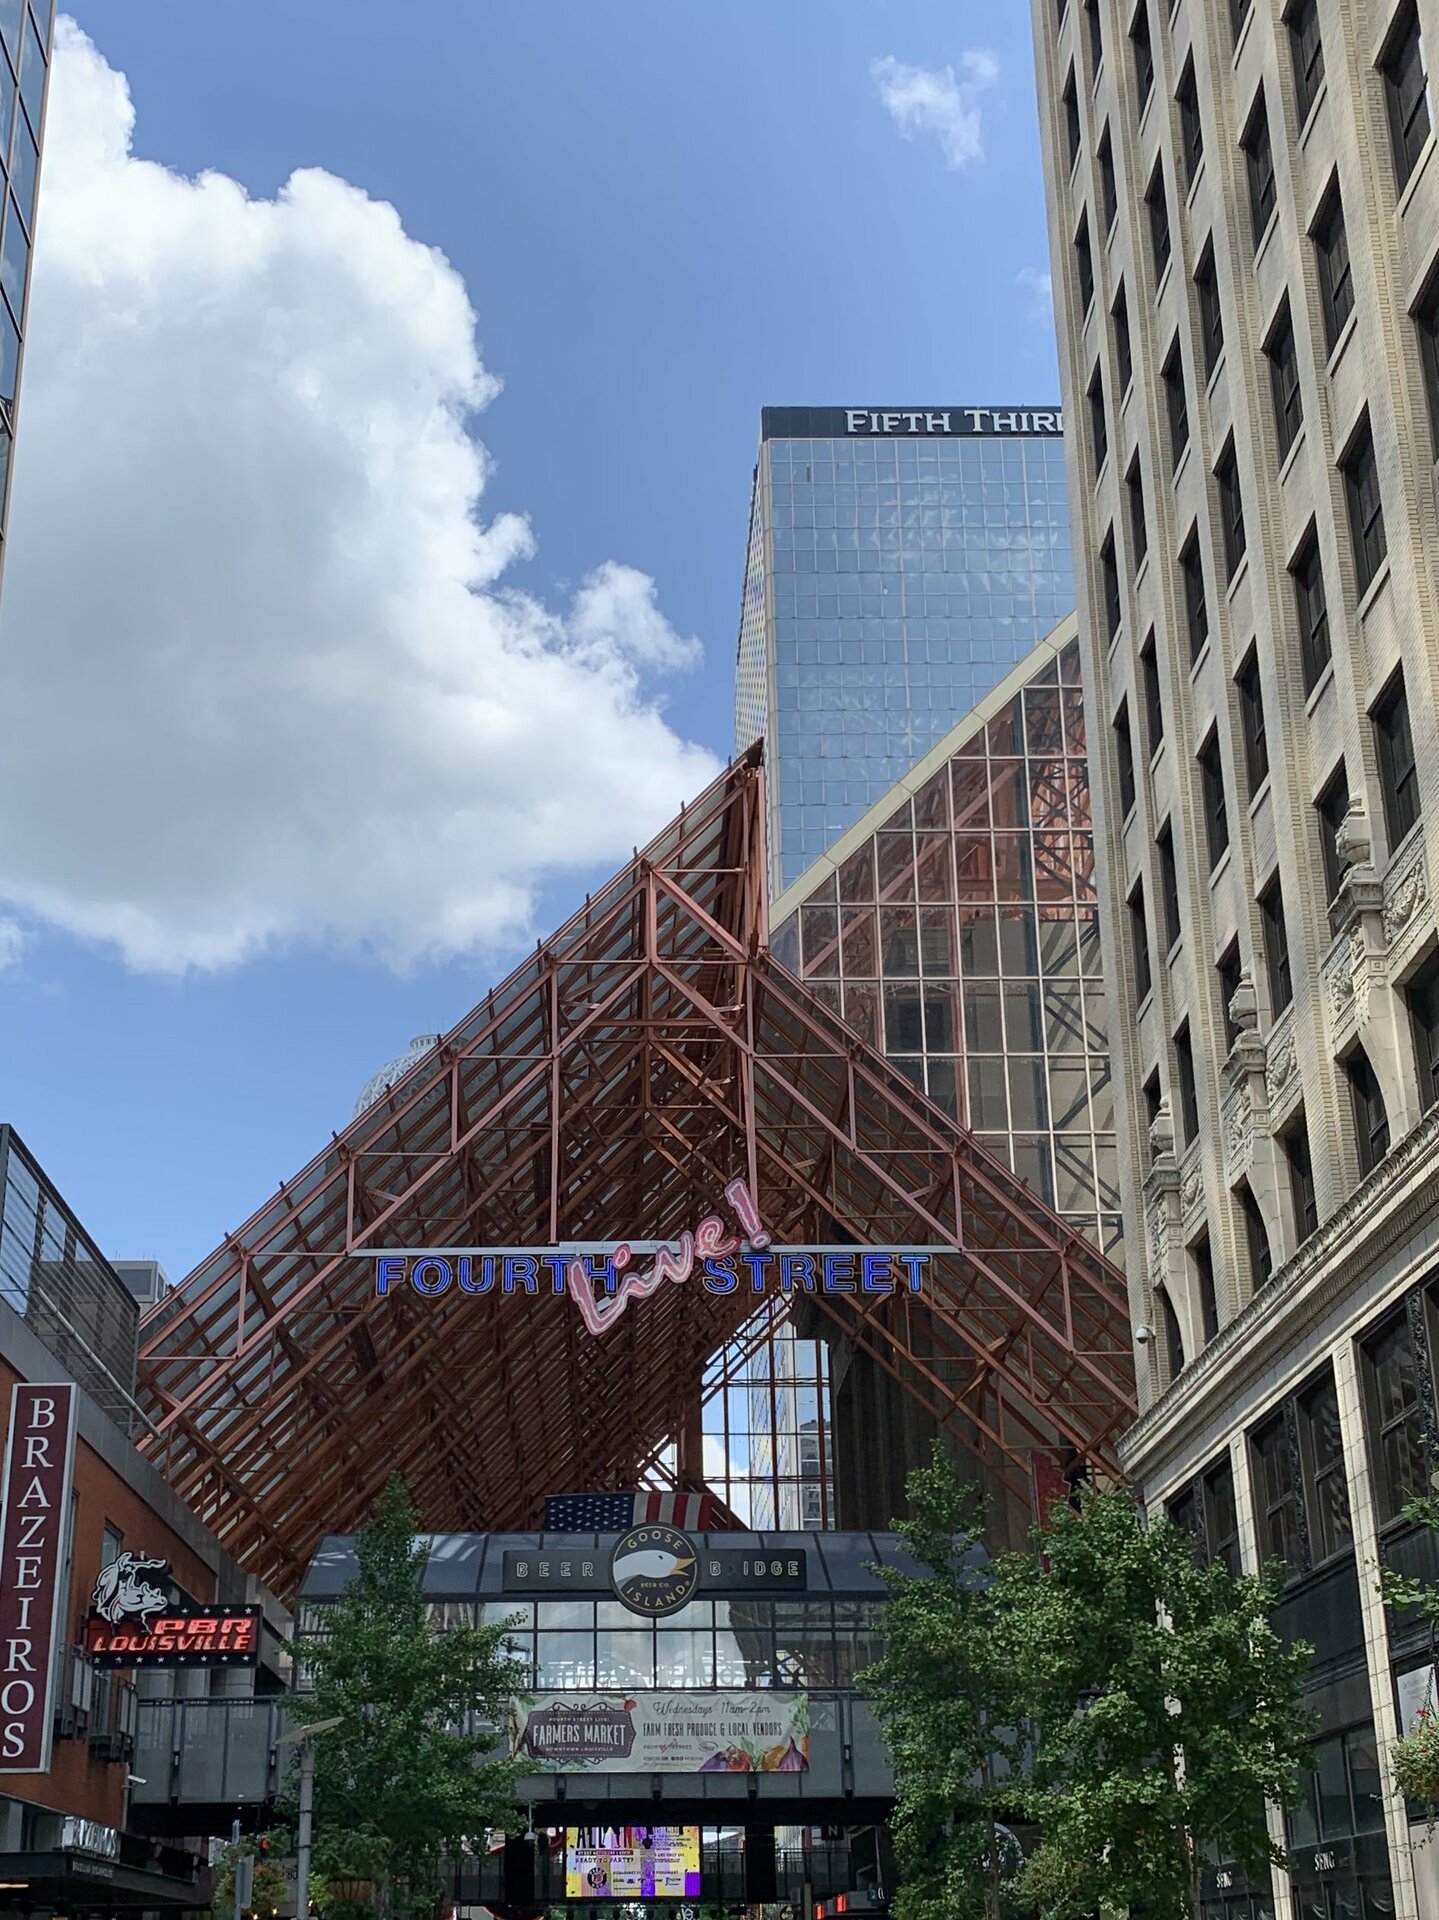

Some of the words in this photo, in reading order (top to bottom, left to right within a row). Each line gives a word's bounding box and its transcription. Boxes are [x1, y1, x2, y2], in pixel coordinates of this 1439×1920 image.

[845, 409, 951, 432] FIFTH
[376, 1255, 618, 1297] FOURTH
[703, 1252, 932, 1295] STREET
[628, 1530, 683, 1550] GOOSE
[1, 1397, 56, 1759] BRAZEIROS
[516, 1562, 594, 1578] BEER
[709, 1561, 799, 1576] BIDGE
[626, 1585, 686, 1607] ISLAND
[154, 1619, 253, 1635] PBR
[92, 1634, 252, 1652] LOUISVILLE
[533, 1725, 580, 1747] FARMERS
[584, 1724, 626, 1746] MARKET
[643, 1722, 661, 1737] FARM
[664, 1722, 684, 1737] FRESH
[687, 1722, 717, 1737] PRODUCE
[728, 1722, 749, 1737] LOCAL
[753, 1722, 783, 1737] VENDORS
